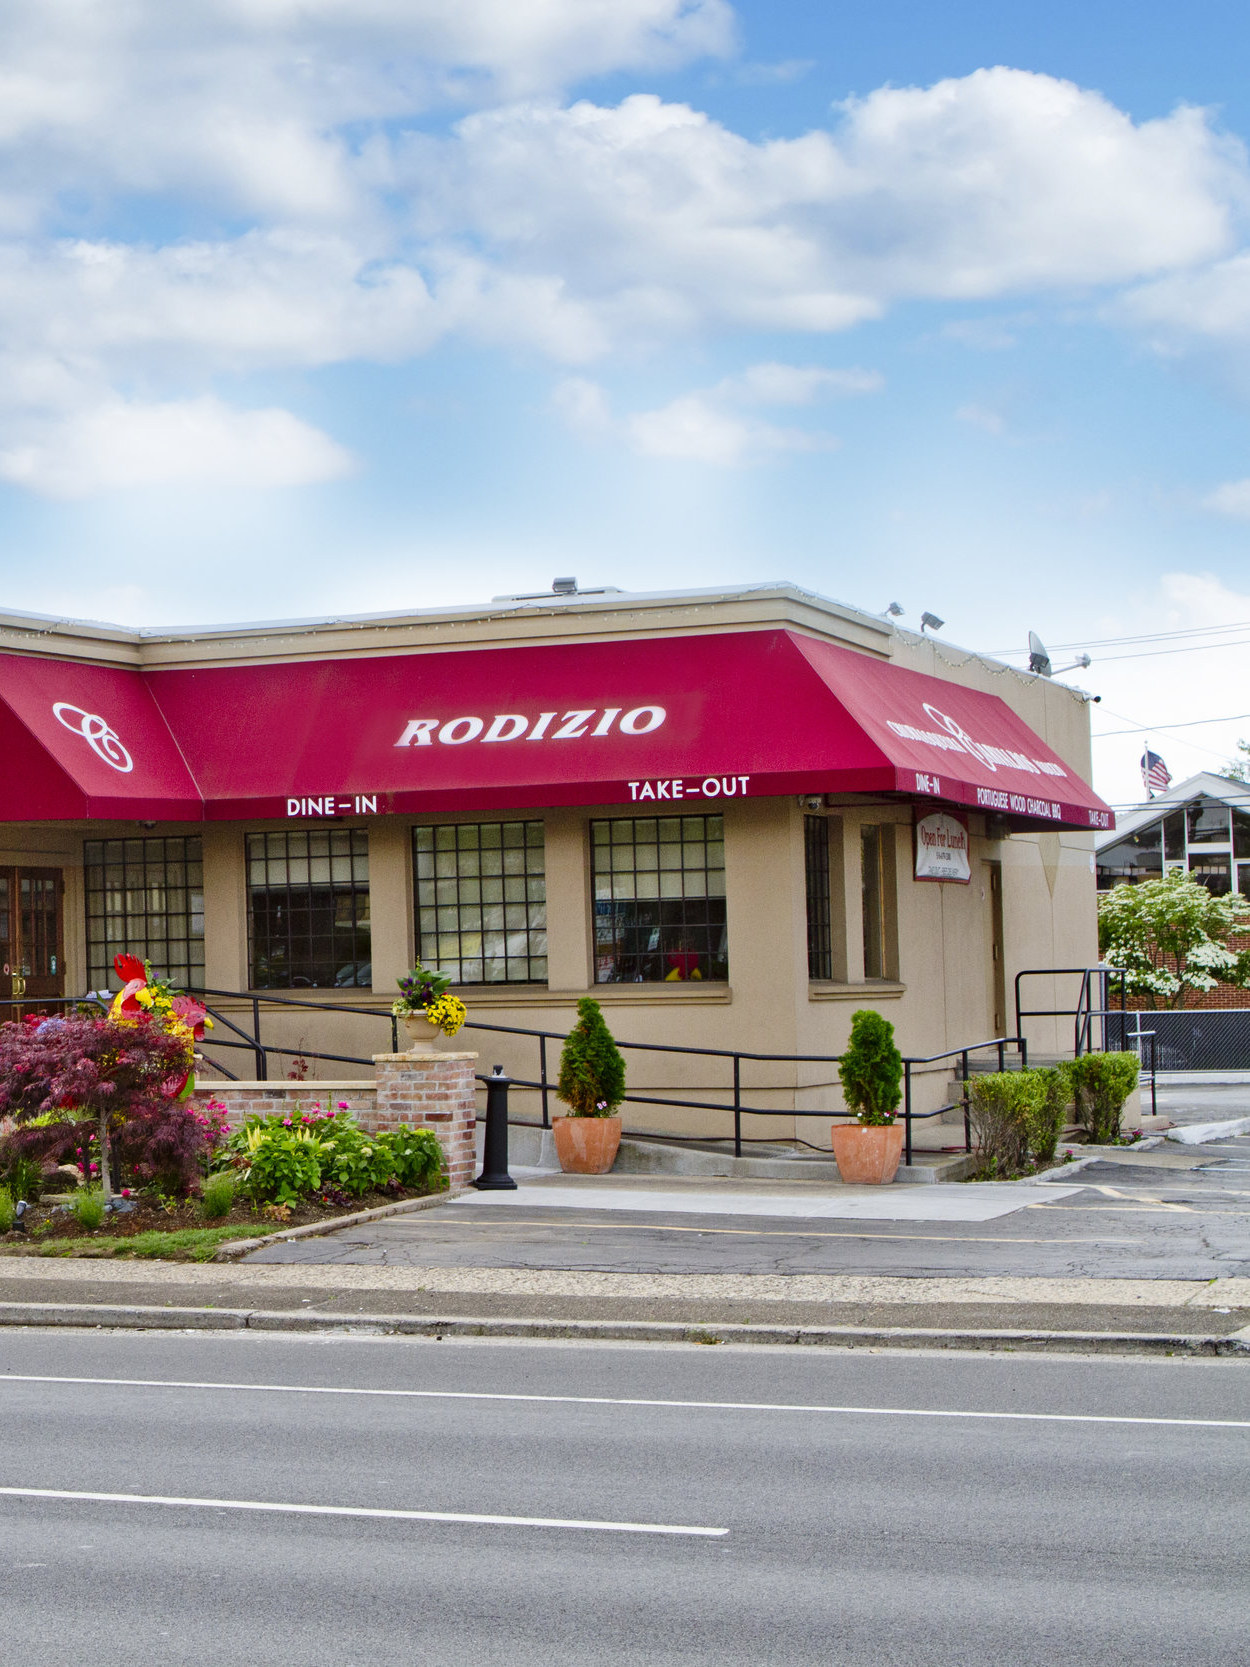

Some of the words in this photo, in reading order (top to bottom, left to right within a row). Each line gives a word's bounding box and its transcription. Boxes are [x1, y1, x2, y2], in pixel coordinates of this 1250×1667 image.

[393, 705, 667, 747] RODIZIO
[627, 776, 750, 801] TAKE-OUT
[915, 773, 941, 795] DINE-IN
[287, 795, 377, 816] DINE-IN
[976, 787, 1009, 810] PORTUGUESE
[1009, 794, 1026, 813] WOOD
[1027, 798, 1052, 818] CHARCOAL
[921, 825, 936, 850] Open
